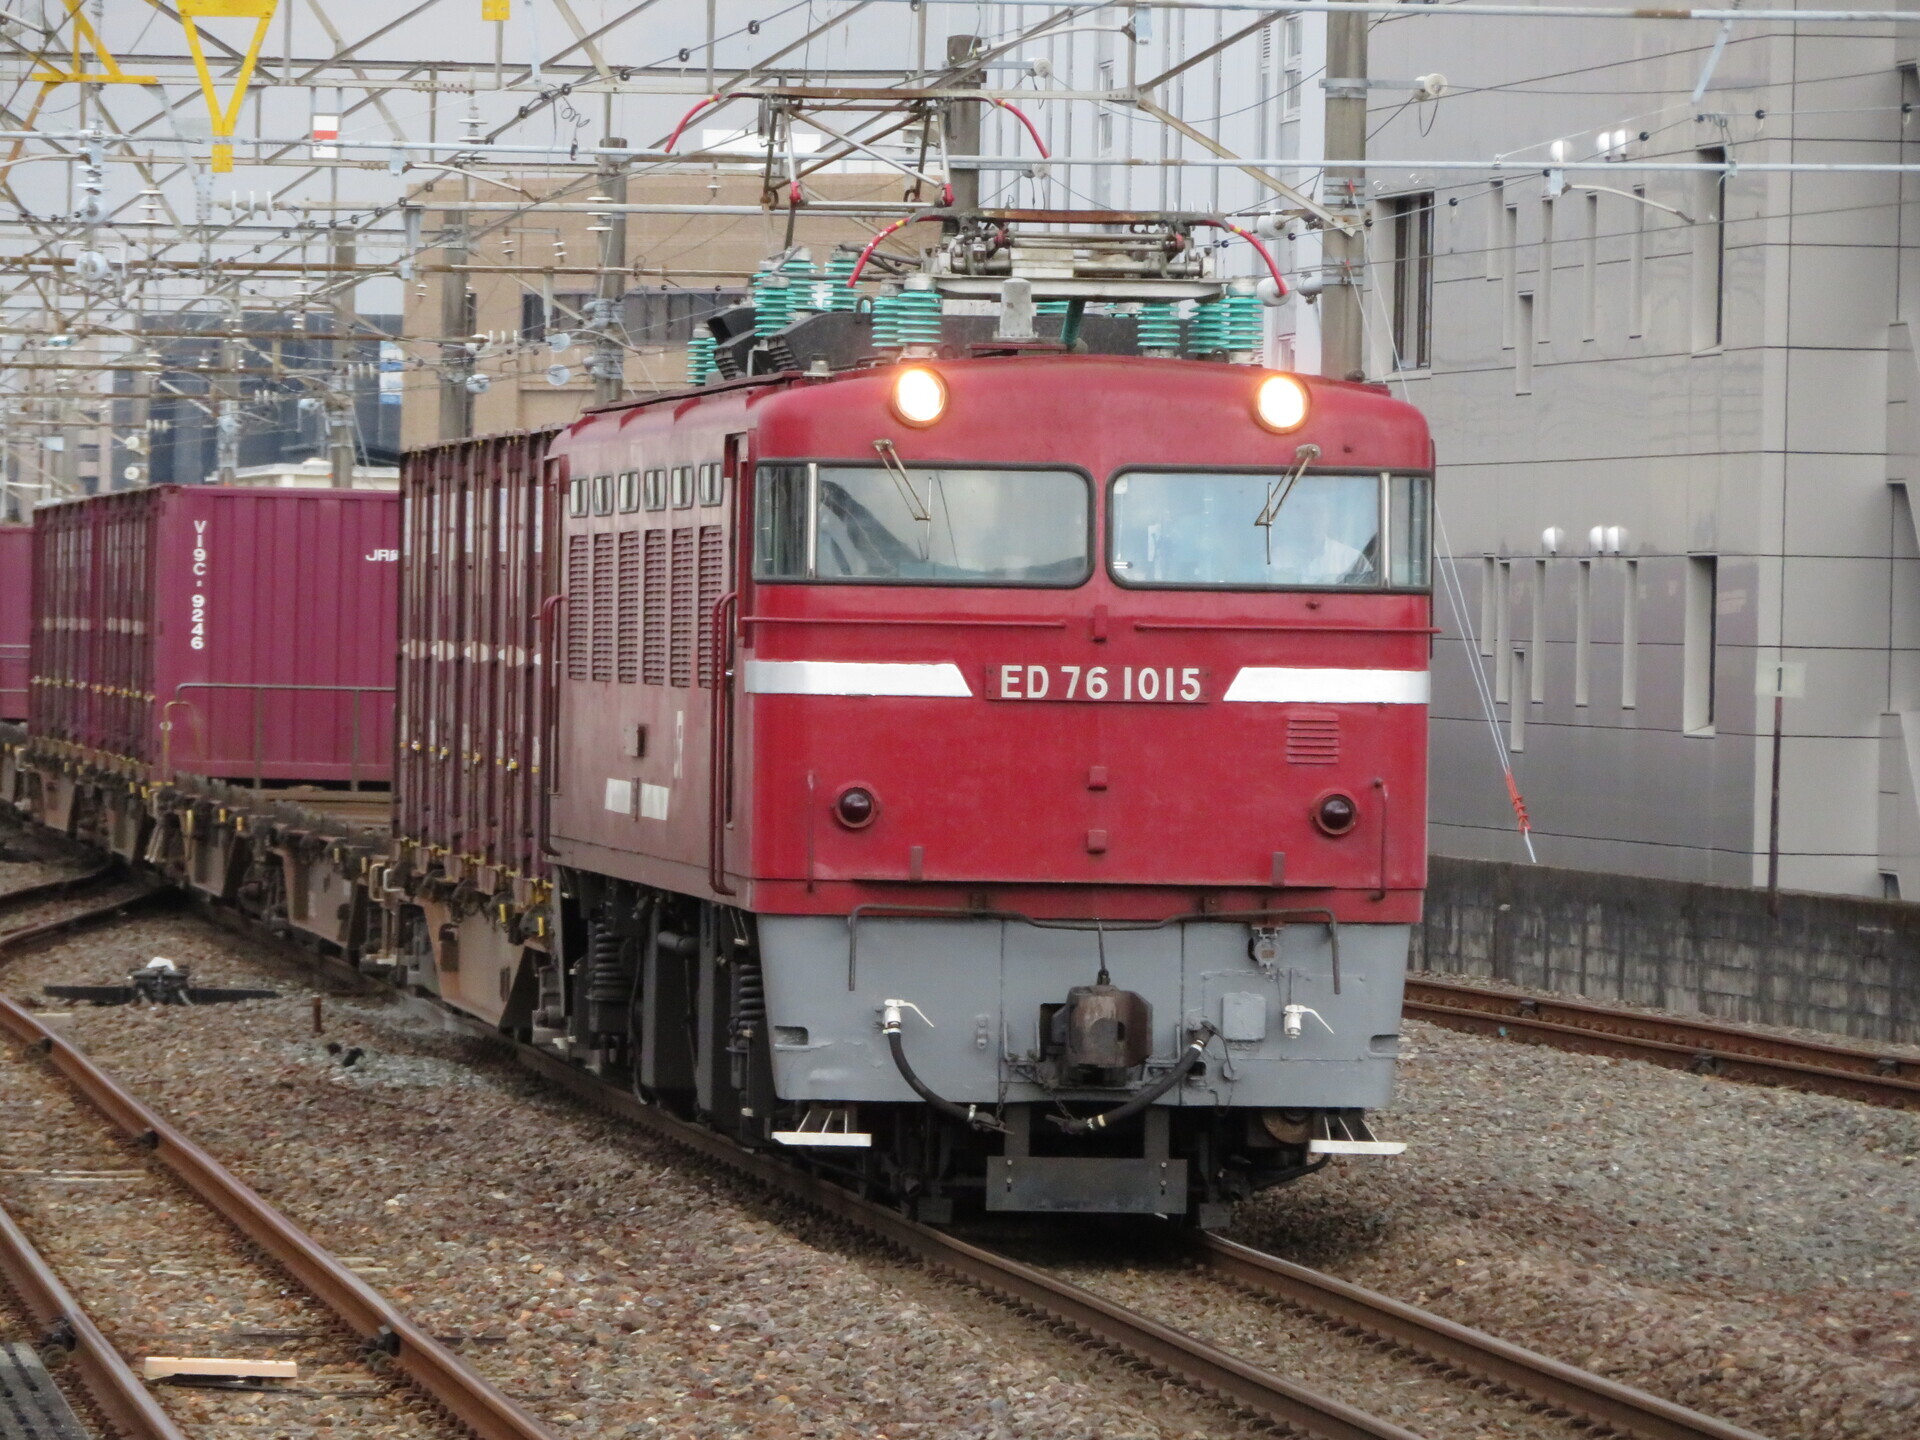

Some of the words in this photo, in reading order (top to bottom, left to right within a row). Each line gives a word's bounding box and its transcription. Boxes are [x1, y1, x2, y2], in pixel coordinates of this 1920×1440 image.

[1000, 664, 1049, 699] ED
[1060, 665, 1109, 700] 76
[1123, 666, 1201, 701] 1015
[1776, 666, 1783, 692] 1
